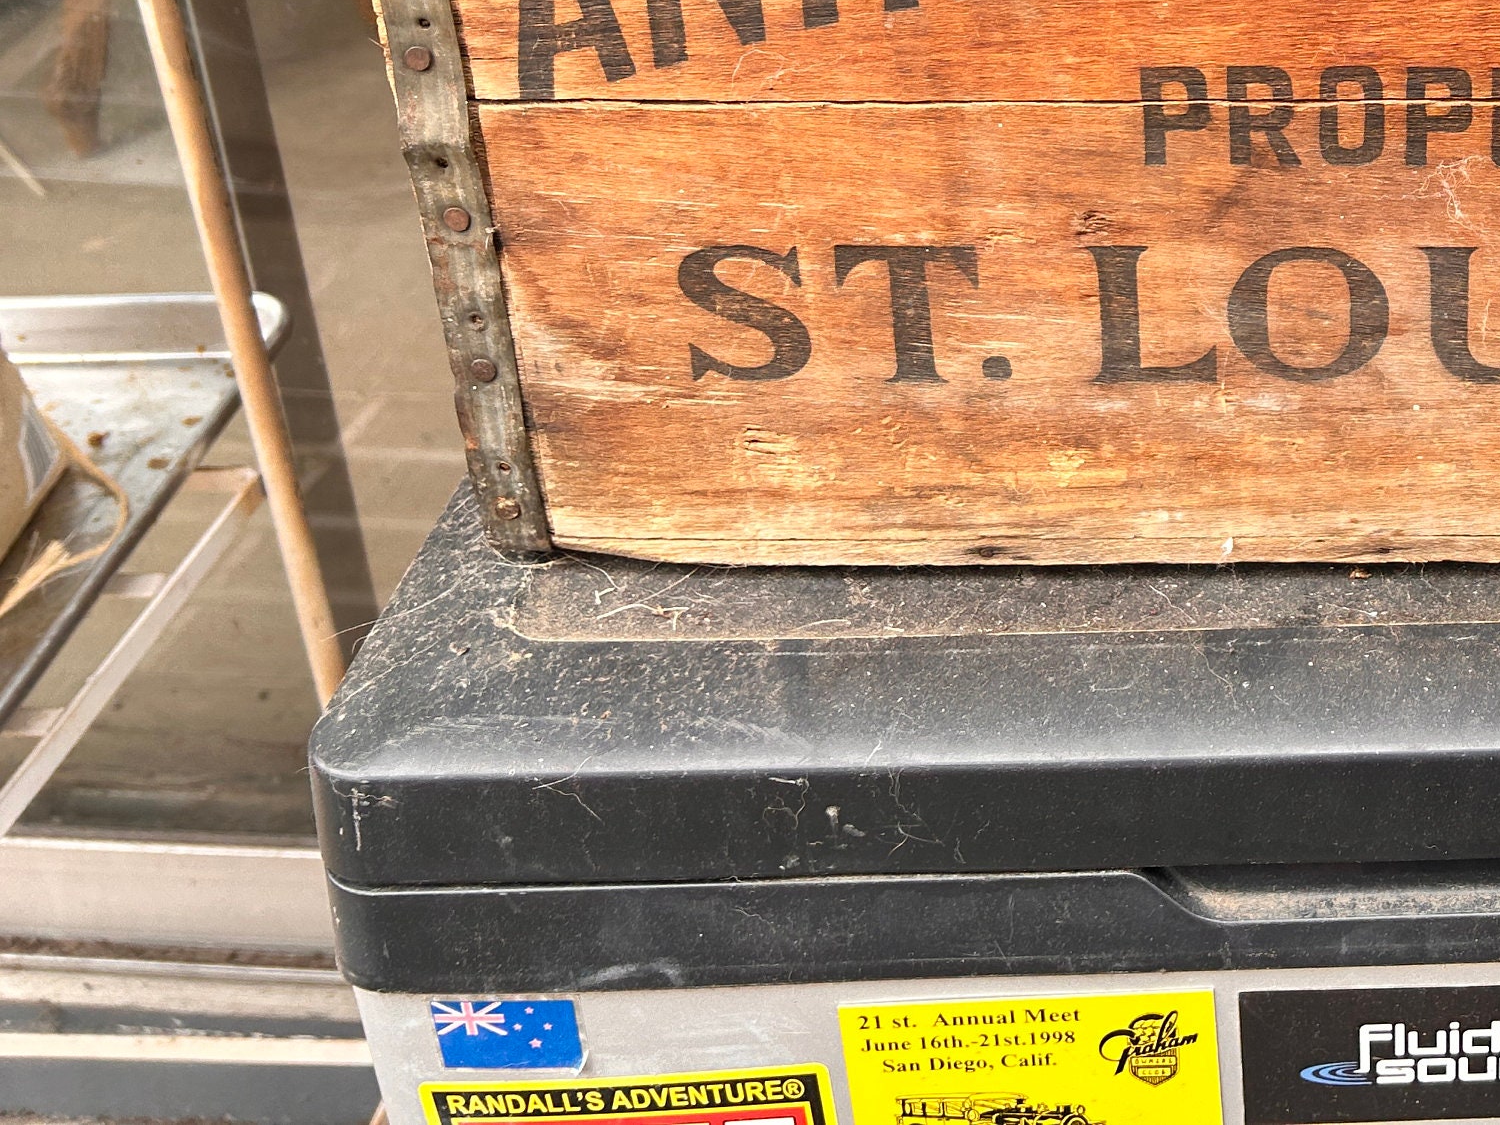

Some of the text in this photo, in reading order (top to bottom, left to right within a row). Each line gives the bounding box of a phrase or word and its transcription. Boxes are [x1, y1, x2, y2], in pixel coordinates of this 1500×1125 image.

[677, 245, 1012, 384] ST.
[933, 1010, 1015, 1027] Annual
[1025, 1008, 1081, 1024] Meet
[861, 1038, 913, 1053] June
[1099, 1010, 1199, 1075] Graham
[882, 1053, 1058, 1074] San Diego, Calif.
[446, 1088, 605, 1116] RANDALL'S
